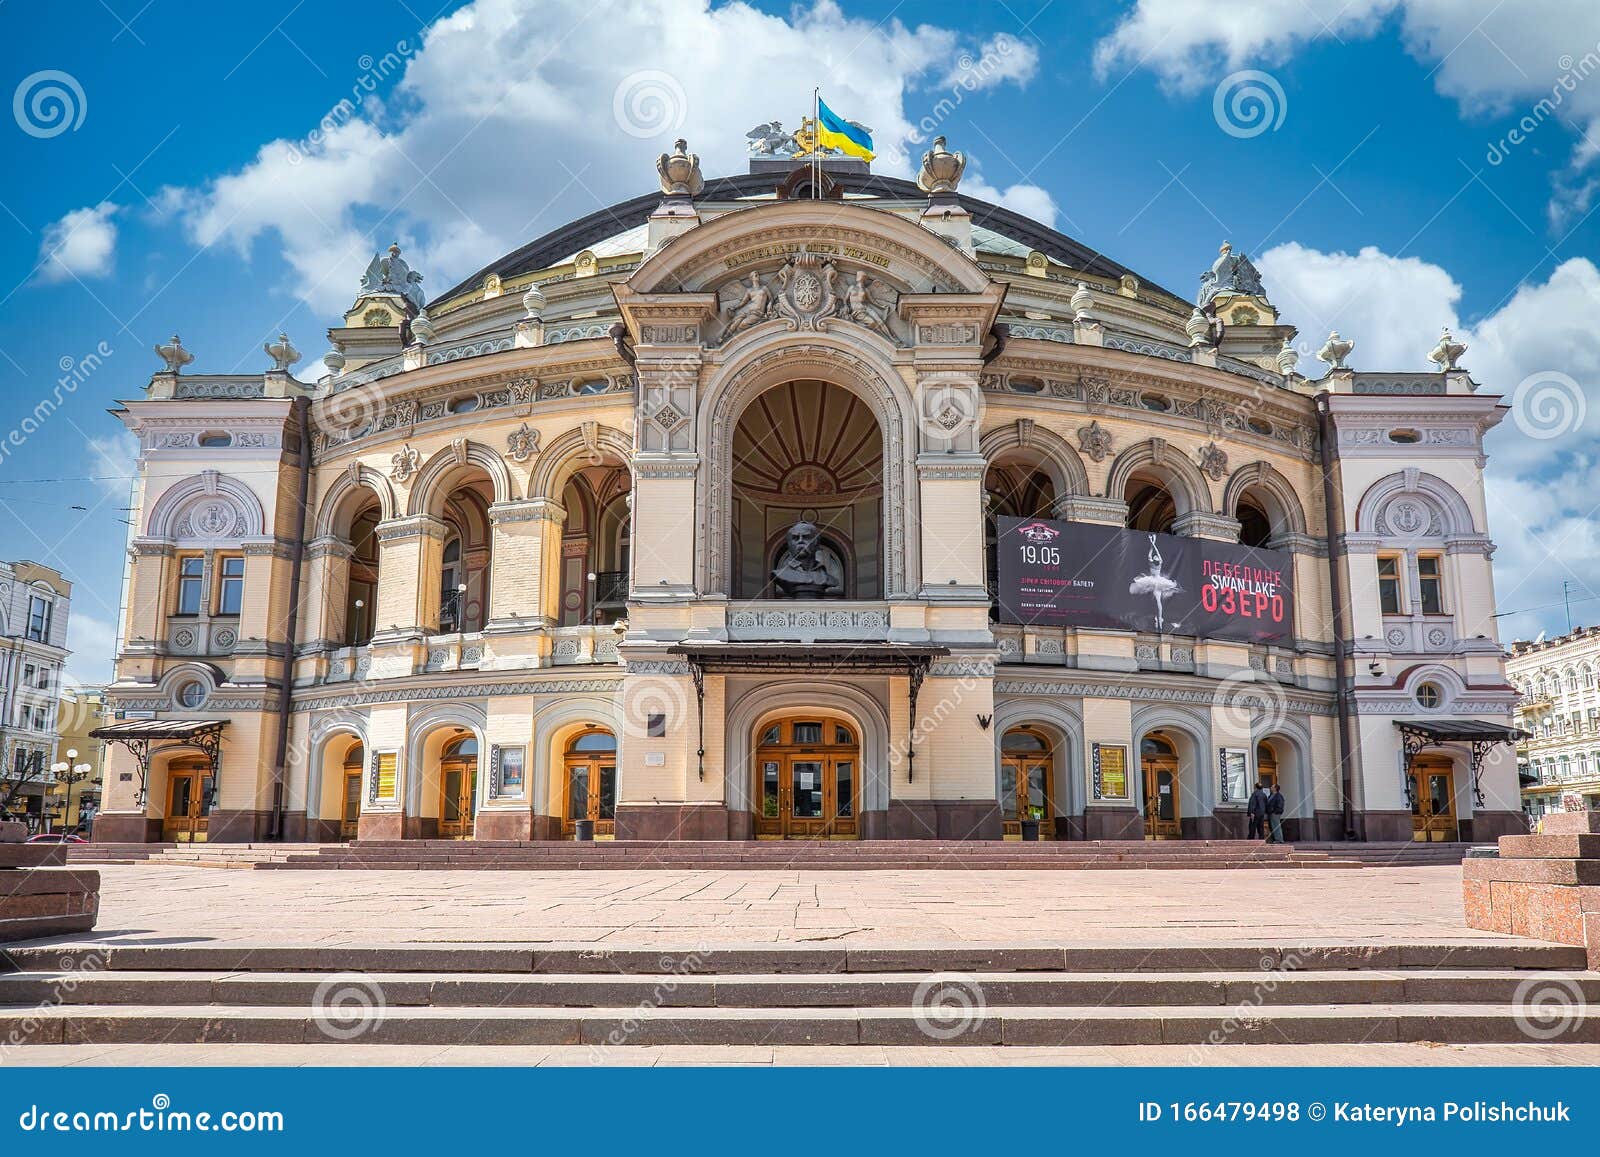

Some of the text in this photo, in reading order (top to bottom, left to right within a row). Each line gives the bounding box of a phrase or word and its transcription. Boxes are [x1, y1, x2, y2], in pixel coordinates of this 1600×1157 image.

[1020, 545, 1060, 565] 19.05
[1203, 560, 1281, 588] ЛЕБЕДИНЕ
[1211, 574, 1276, 598] SWAN LAKE
[1202, 584, 1284, 623] ОЗЕРО
